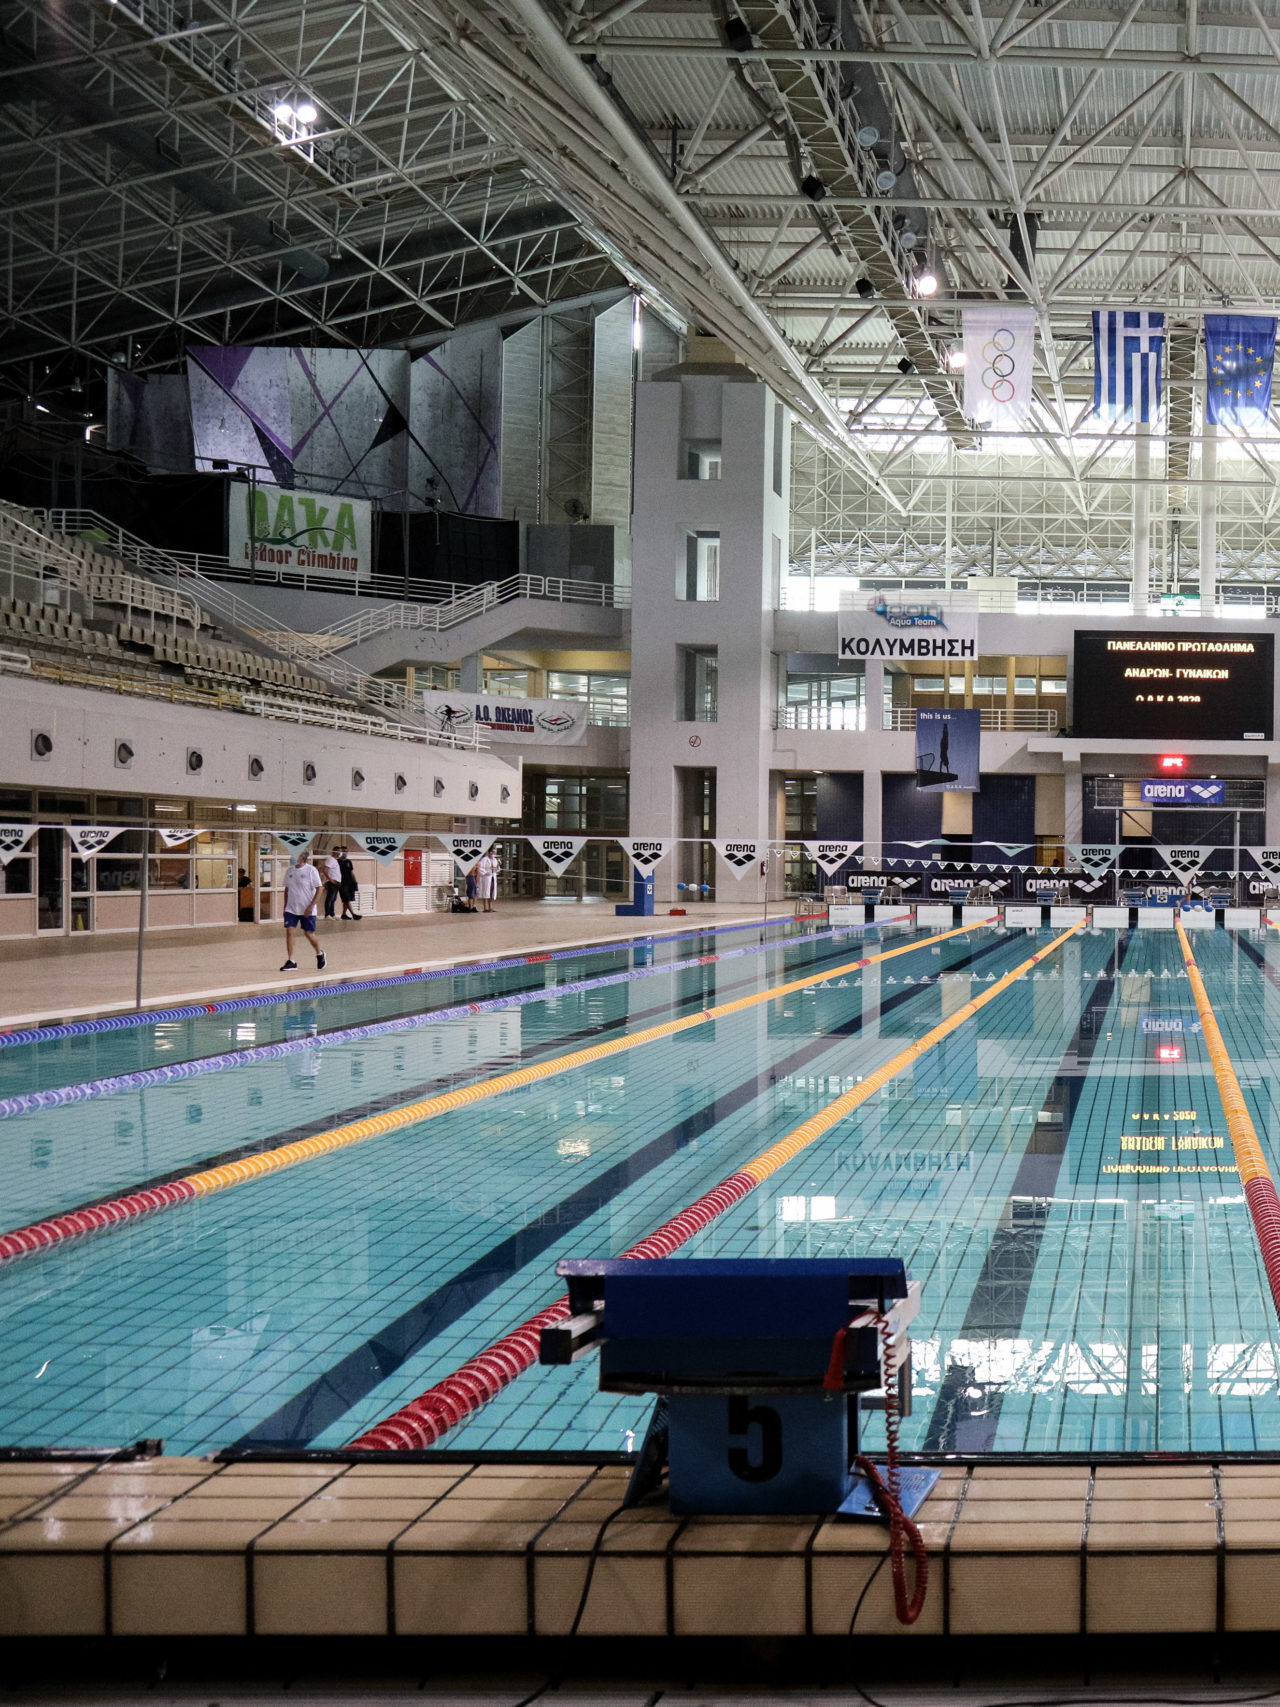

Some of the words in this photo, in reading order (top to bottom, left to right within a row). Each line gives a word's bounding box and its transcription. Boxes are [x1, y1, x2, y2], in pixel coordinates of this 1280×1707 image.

[297, 548, 358, 572] Climbing
[890, 617, 912, 628] Aqua
[913, 617, 937, 626] Team
[841, 637, 975, 657] ΚΟΛΥΜΒΗΣΗ
[1107, 640, 1175, 651] ΠΑΝΕΛΛΗΝΙΟ
[1176, 668, 1229, 679] ΓΥΝΑΙΚΩΝ
[495, 706, 534, 725] ΩΚΕΑΝΟΣ
[920, 712, 933, 720] this
[935, 712, 941, 720] is
[516, 724, 535, 733] TEAM
[1144, 784, 1185, 798] arena
[0, 829, 23, 838] rena
[365, 835, 396, 845] arena
[452, 838, 482, 848] arena
[542, 839, 573, 850] arena
[632, 840, 662, 851] arena
[725, 842, 756, 853] arena
[818, 843, 848, 853] arena
[1081, 847, 1111, 856] arena
[1170, 848, 1200, 859] arena
[849, 875, 888, 888] arena
[931, 878, 974, 892] arena
[728, 1395, 783, 1483] 5
